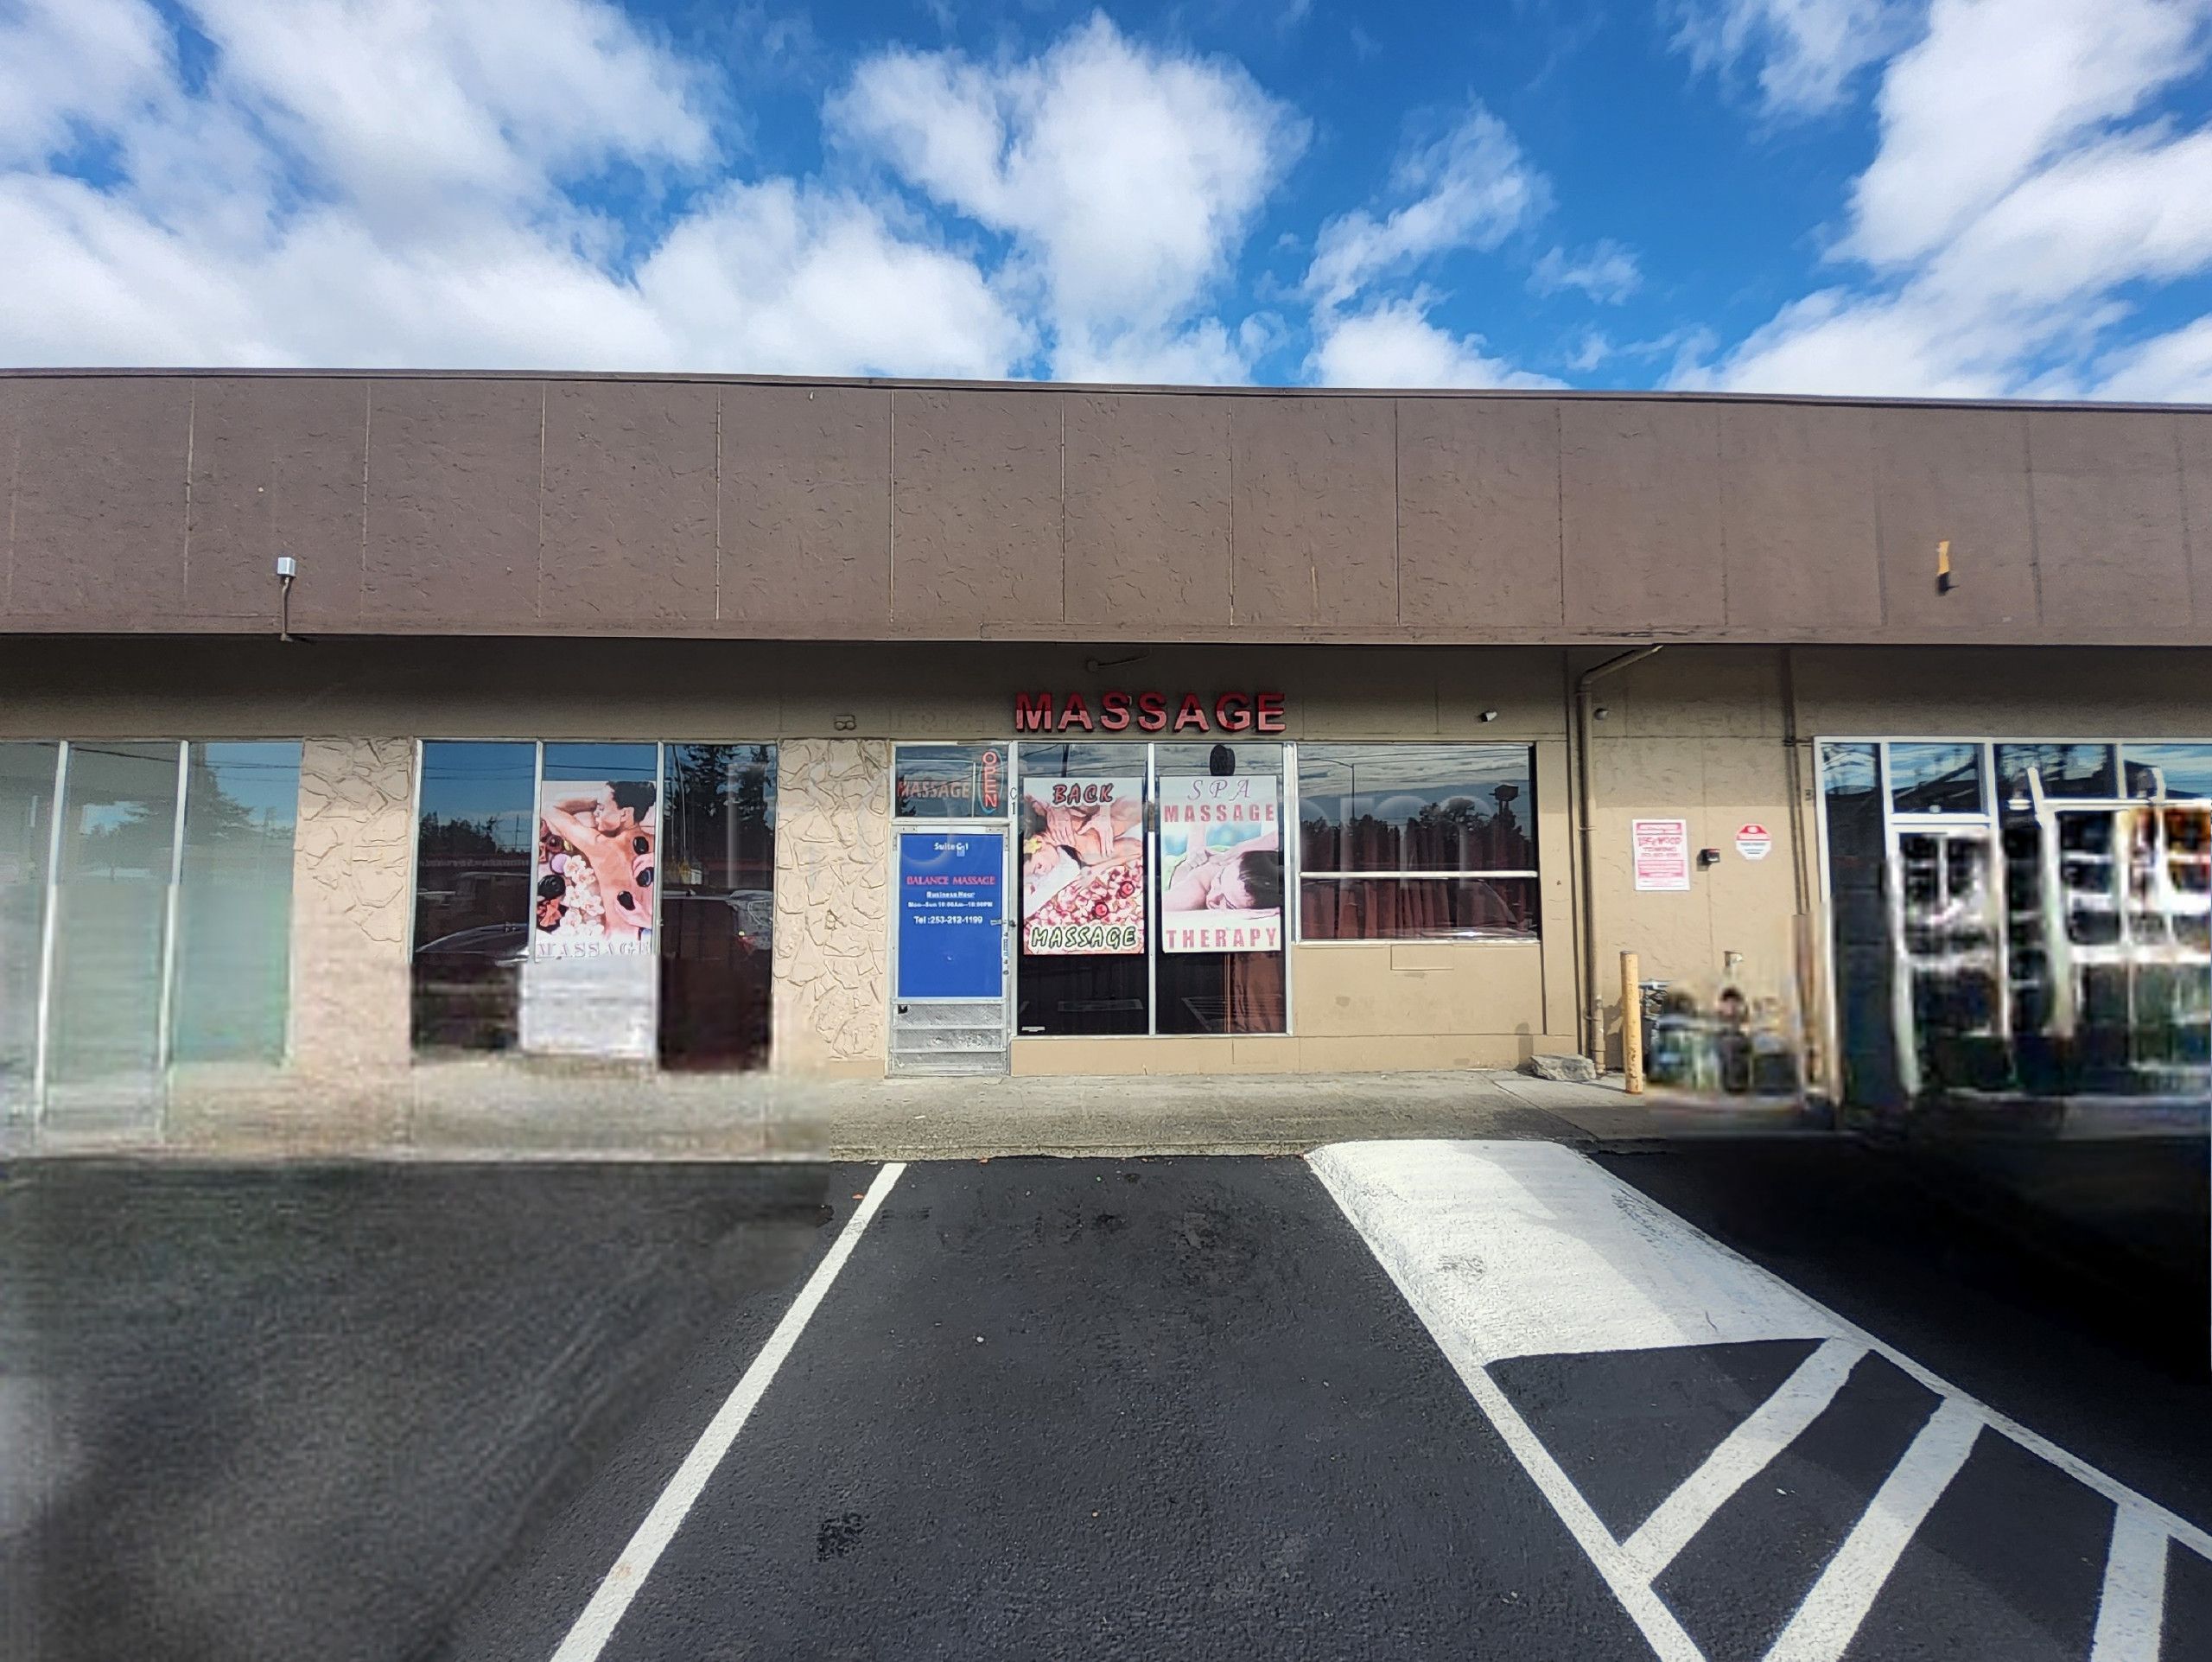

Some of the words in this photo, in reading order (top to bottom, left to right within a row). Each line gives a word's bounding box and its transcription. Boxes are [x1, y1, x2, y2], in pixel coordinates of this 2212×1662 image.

[1015, 691, 1287, 734] MASSAGE
[898, 780, 969, 799] MASSAGE
[982, 751, 998, 808] OPEN
[1052, 784, 1114, 805] BACK
[1187, 780, 1252, 801] SPA
[1164, 804, 1275, 824] MASSAGE
[906, 876, 948, 885] BALANCE
[953, 876, 995, 885] MASSAGE
[1031, 926, 1136, 948] MASSAGE
[1166, 928, 1277, 948] THERAPY
[537, 941, 652, 957] MASSAGE
